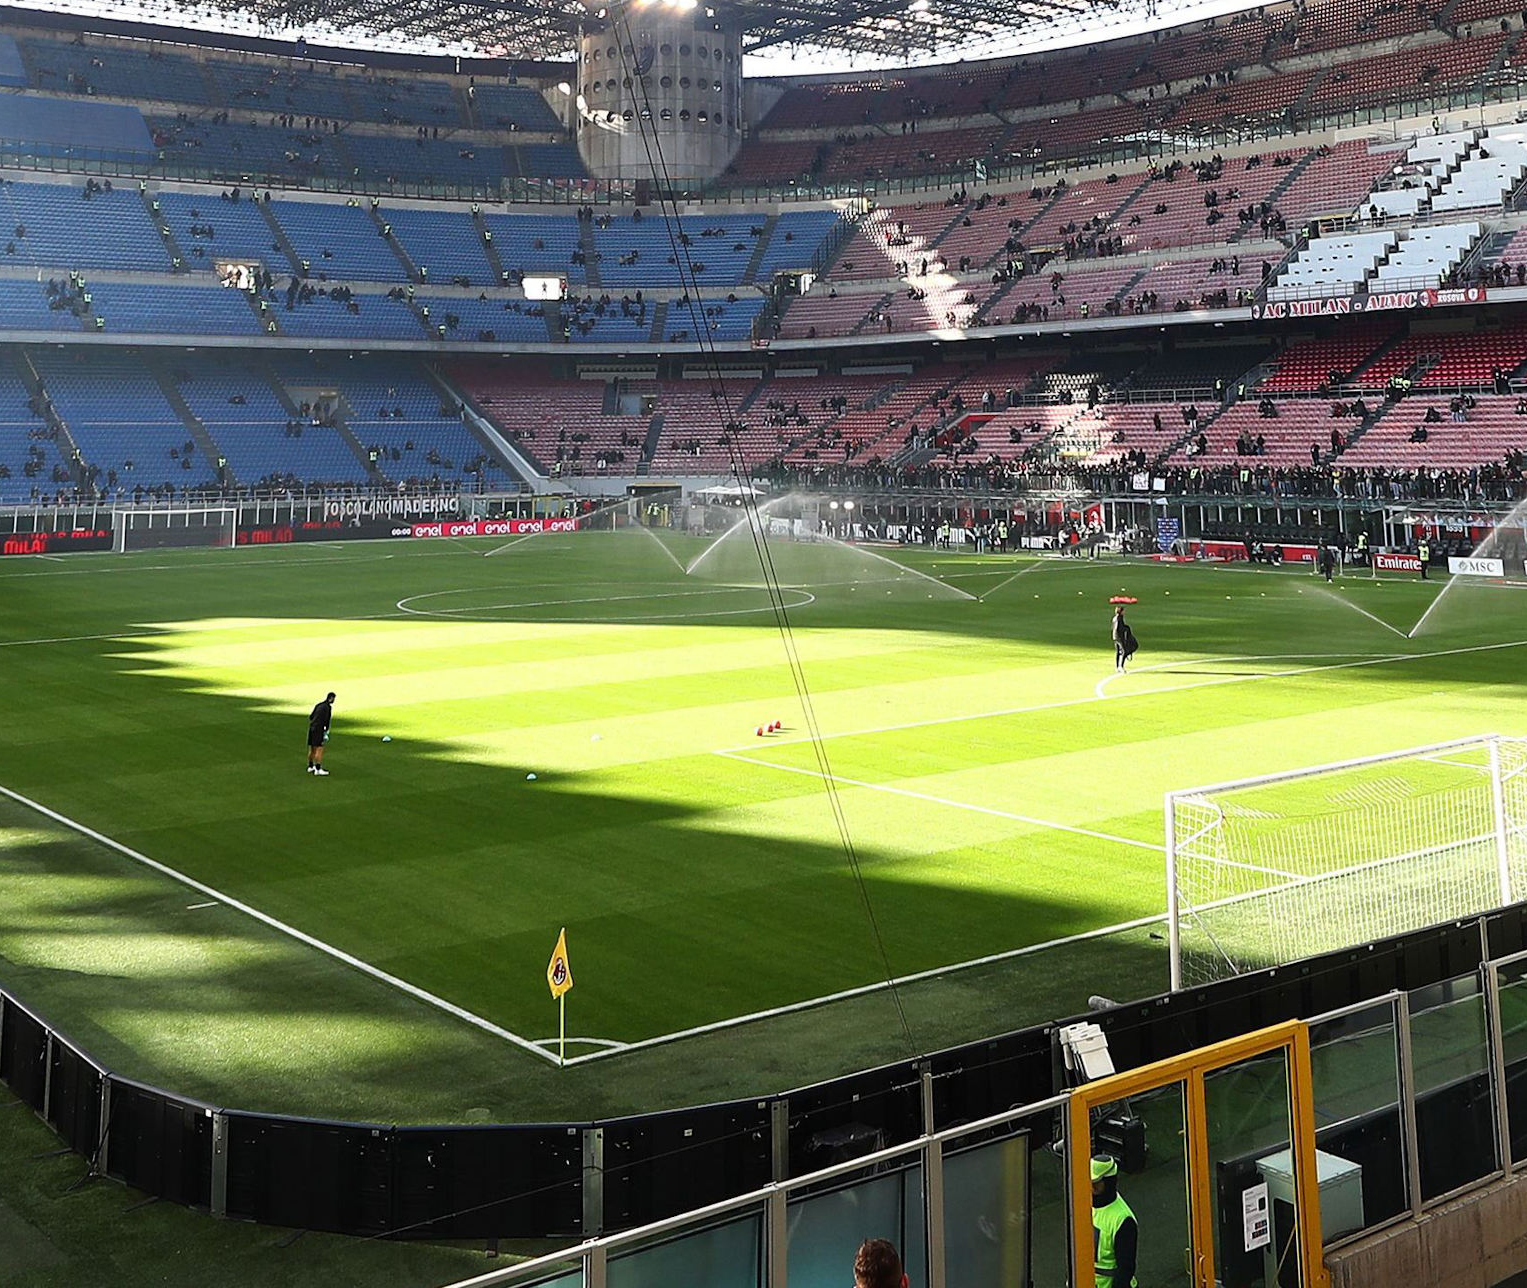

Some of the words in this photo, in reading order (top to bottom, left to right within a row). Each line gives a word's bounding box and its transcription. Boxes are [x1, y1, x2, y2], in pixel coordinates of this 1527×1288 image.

[1437, 293, 1466, 303] KOSOVA
[1262, 306, 1286, 319] AC
[1289, 298, 1351, 317] MILAN
[415, 524, 442, 537] enel
[450, 522, 477, 536] enel
[484, 521, 511, 535] enel
[518, 520, 544, 533] enel
[551, 518, 575, 531] enel
[937, 527, 965, 544] PMA
[1469, 562, 1495, 572] MSC
